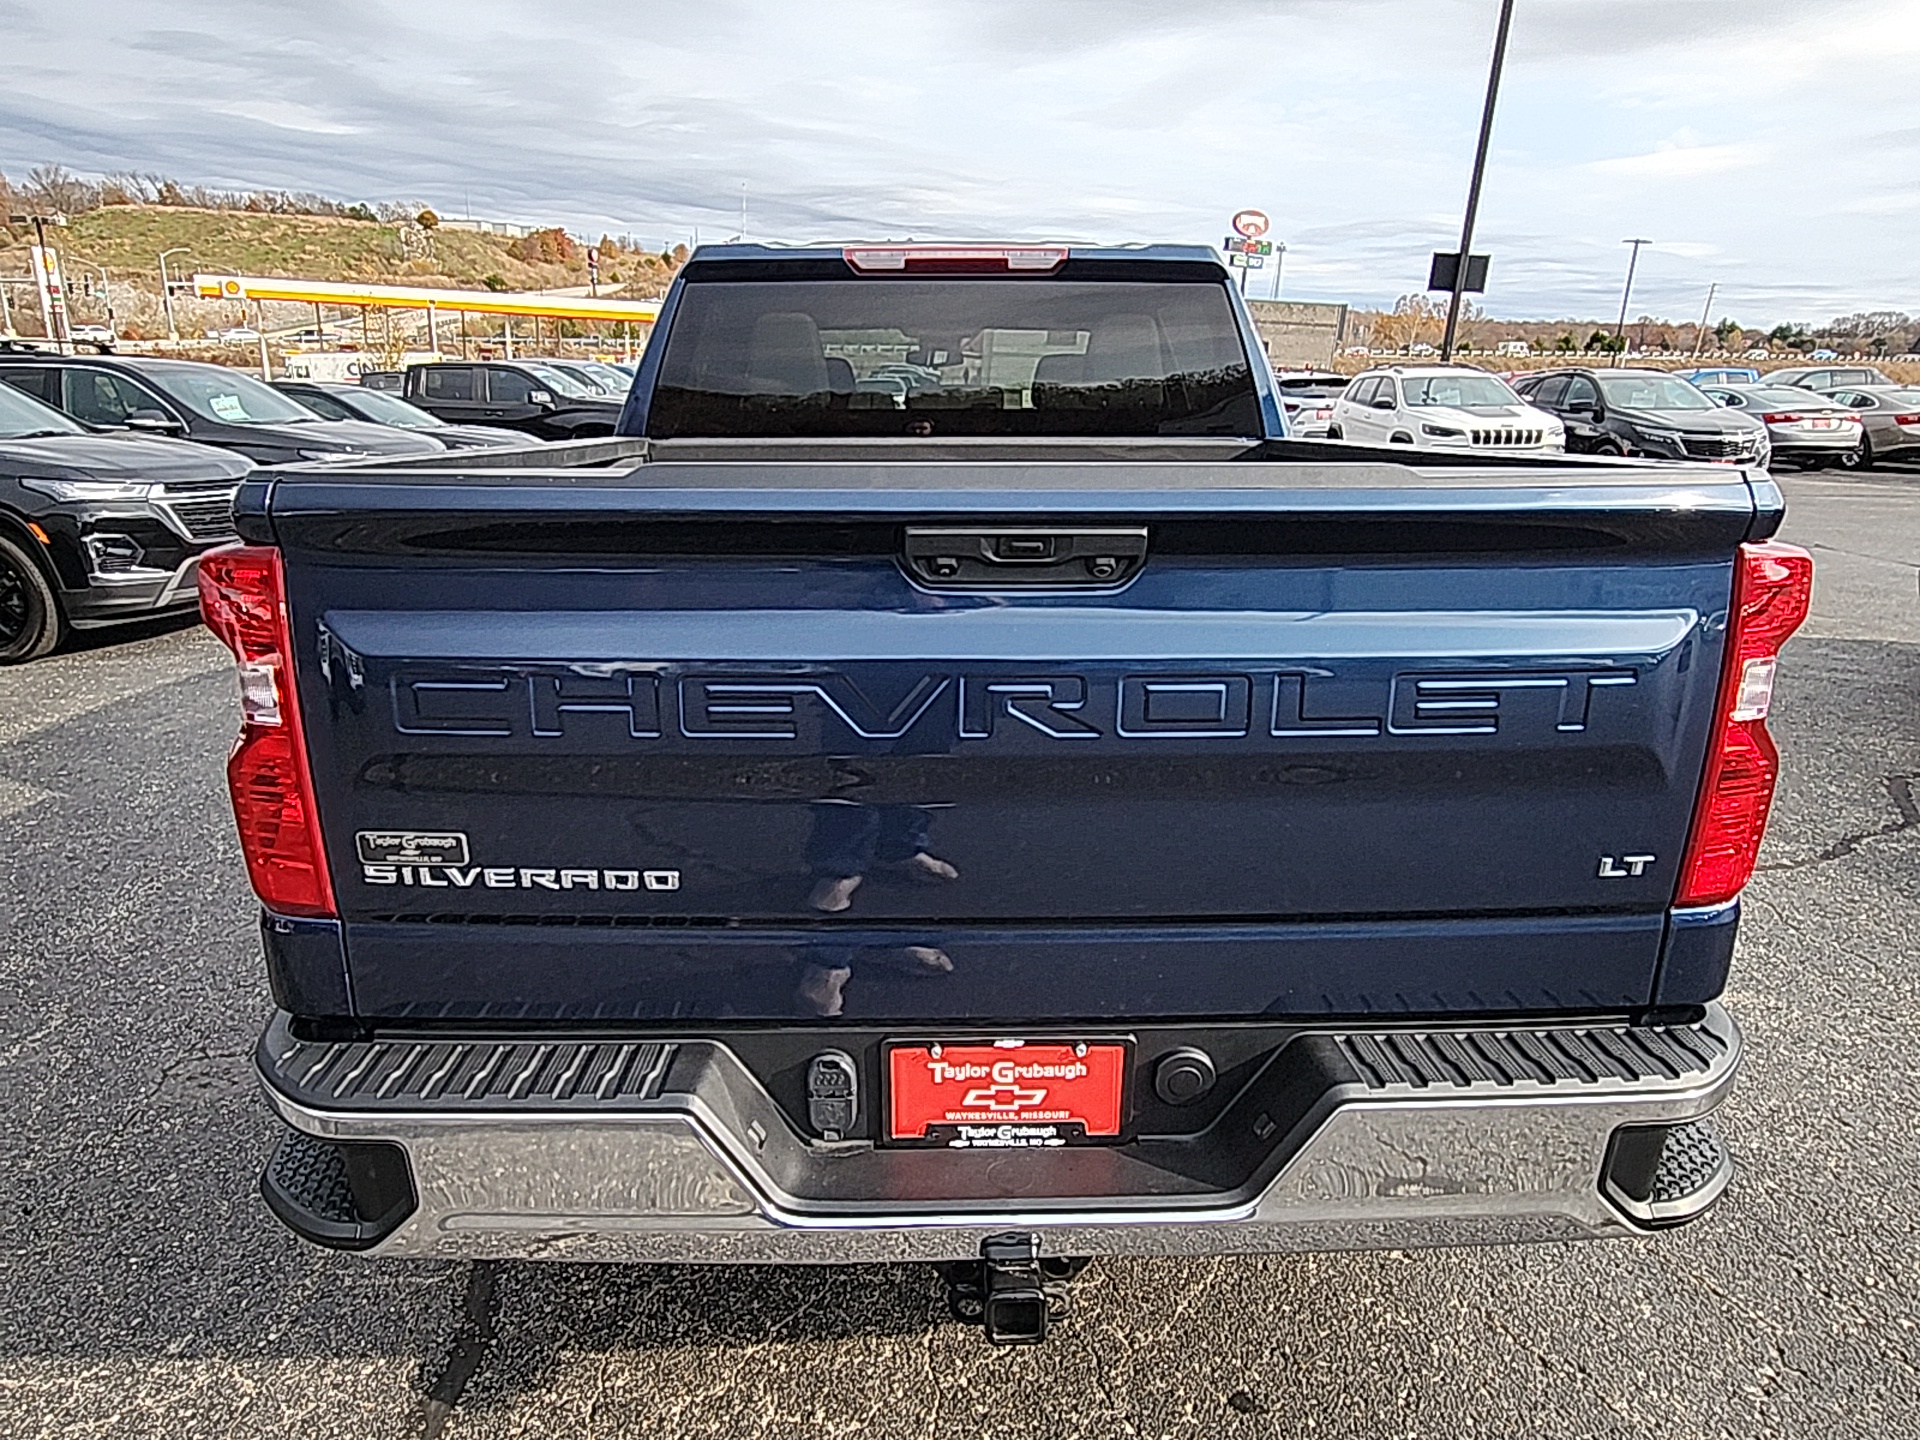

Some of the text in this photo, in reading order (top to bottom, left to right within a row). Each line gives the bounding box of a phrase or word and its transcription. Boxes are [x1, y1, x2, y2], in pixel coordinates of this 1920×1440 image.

[391, 672, 1638, 739] CHEVROLET
[1598, 855, 1655, 877] LT
[363, 865, 680, 890] SILVERADO
[927, 1061, 1087, 1083] Taylor Grubaugh
[944, 1110, 1071, 1121] WAYNESVILLE, MISSOURI
[957, 1125, 1057, 1140] Taylor Grubaugh
